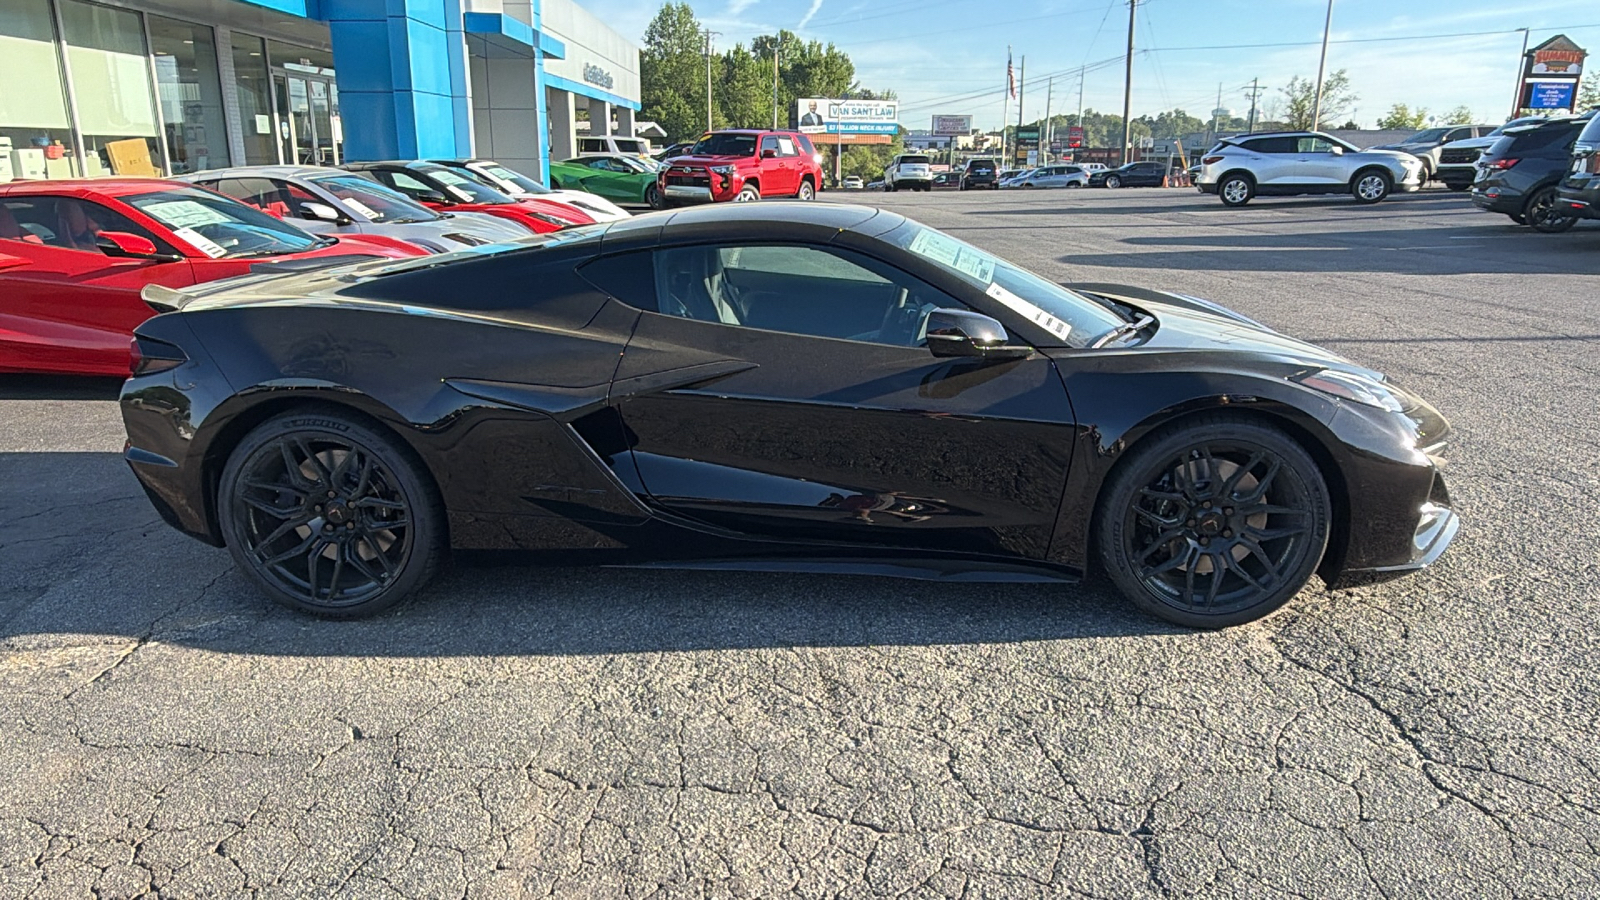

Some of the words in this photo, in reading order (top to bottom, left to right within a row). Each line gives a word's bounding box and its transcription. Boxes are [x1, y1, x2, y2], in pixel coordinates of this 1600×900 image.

[832, 107, 849, 115] VAN
[851, 108, 873, 116] SANT
[875, 108, 893, 116] LAW
[294, 419, 349, 432] MICHELIN
